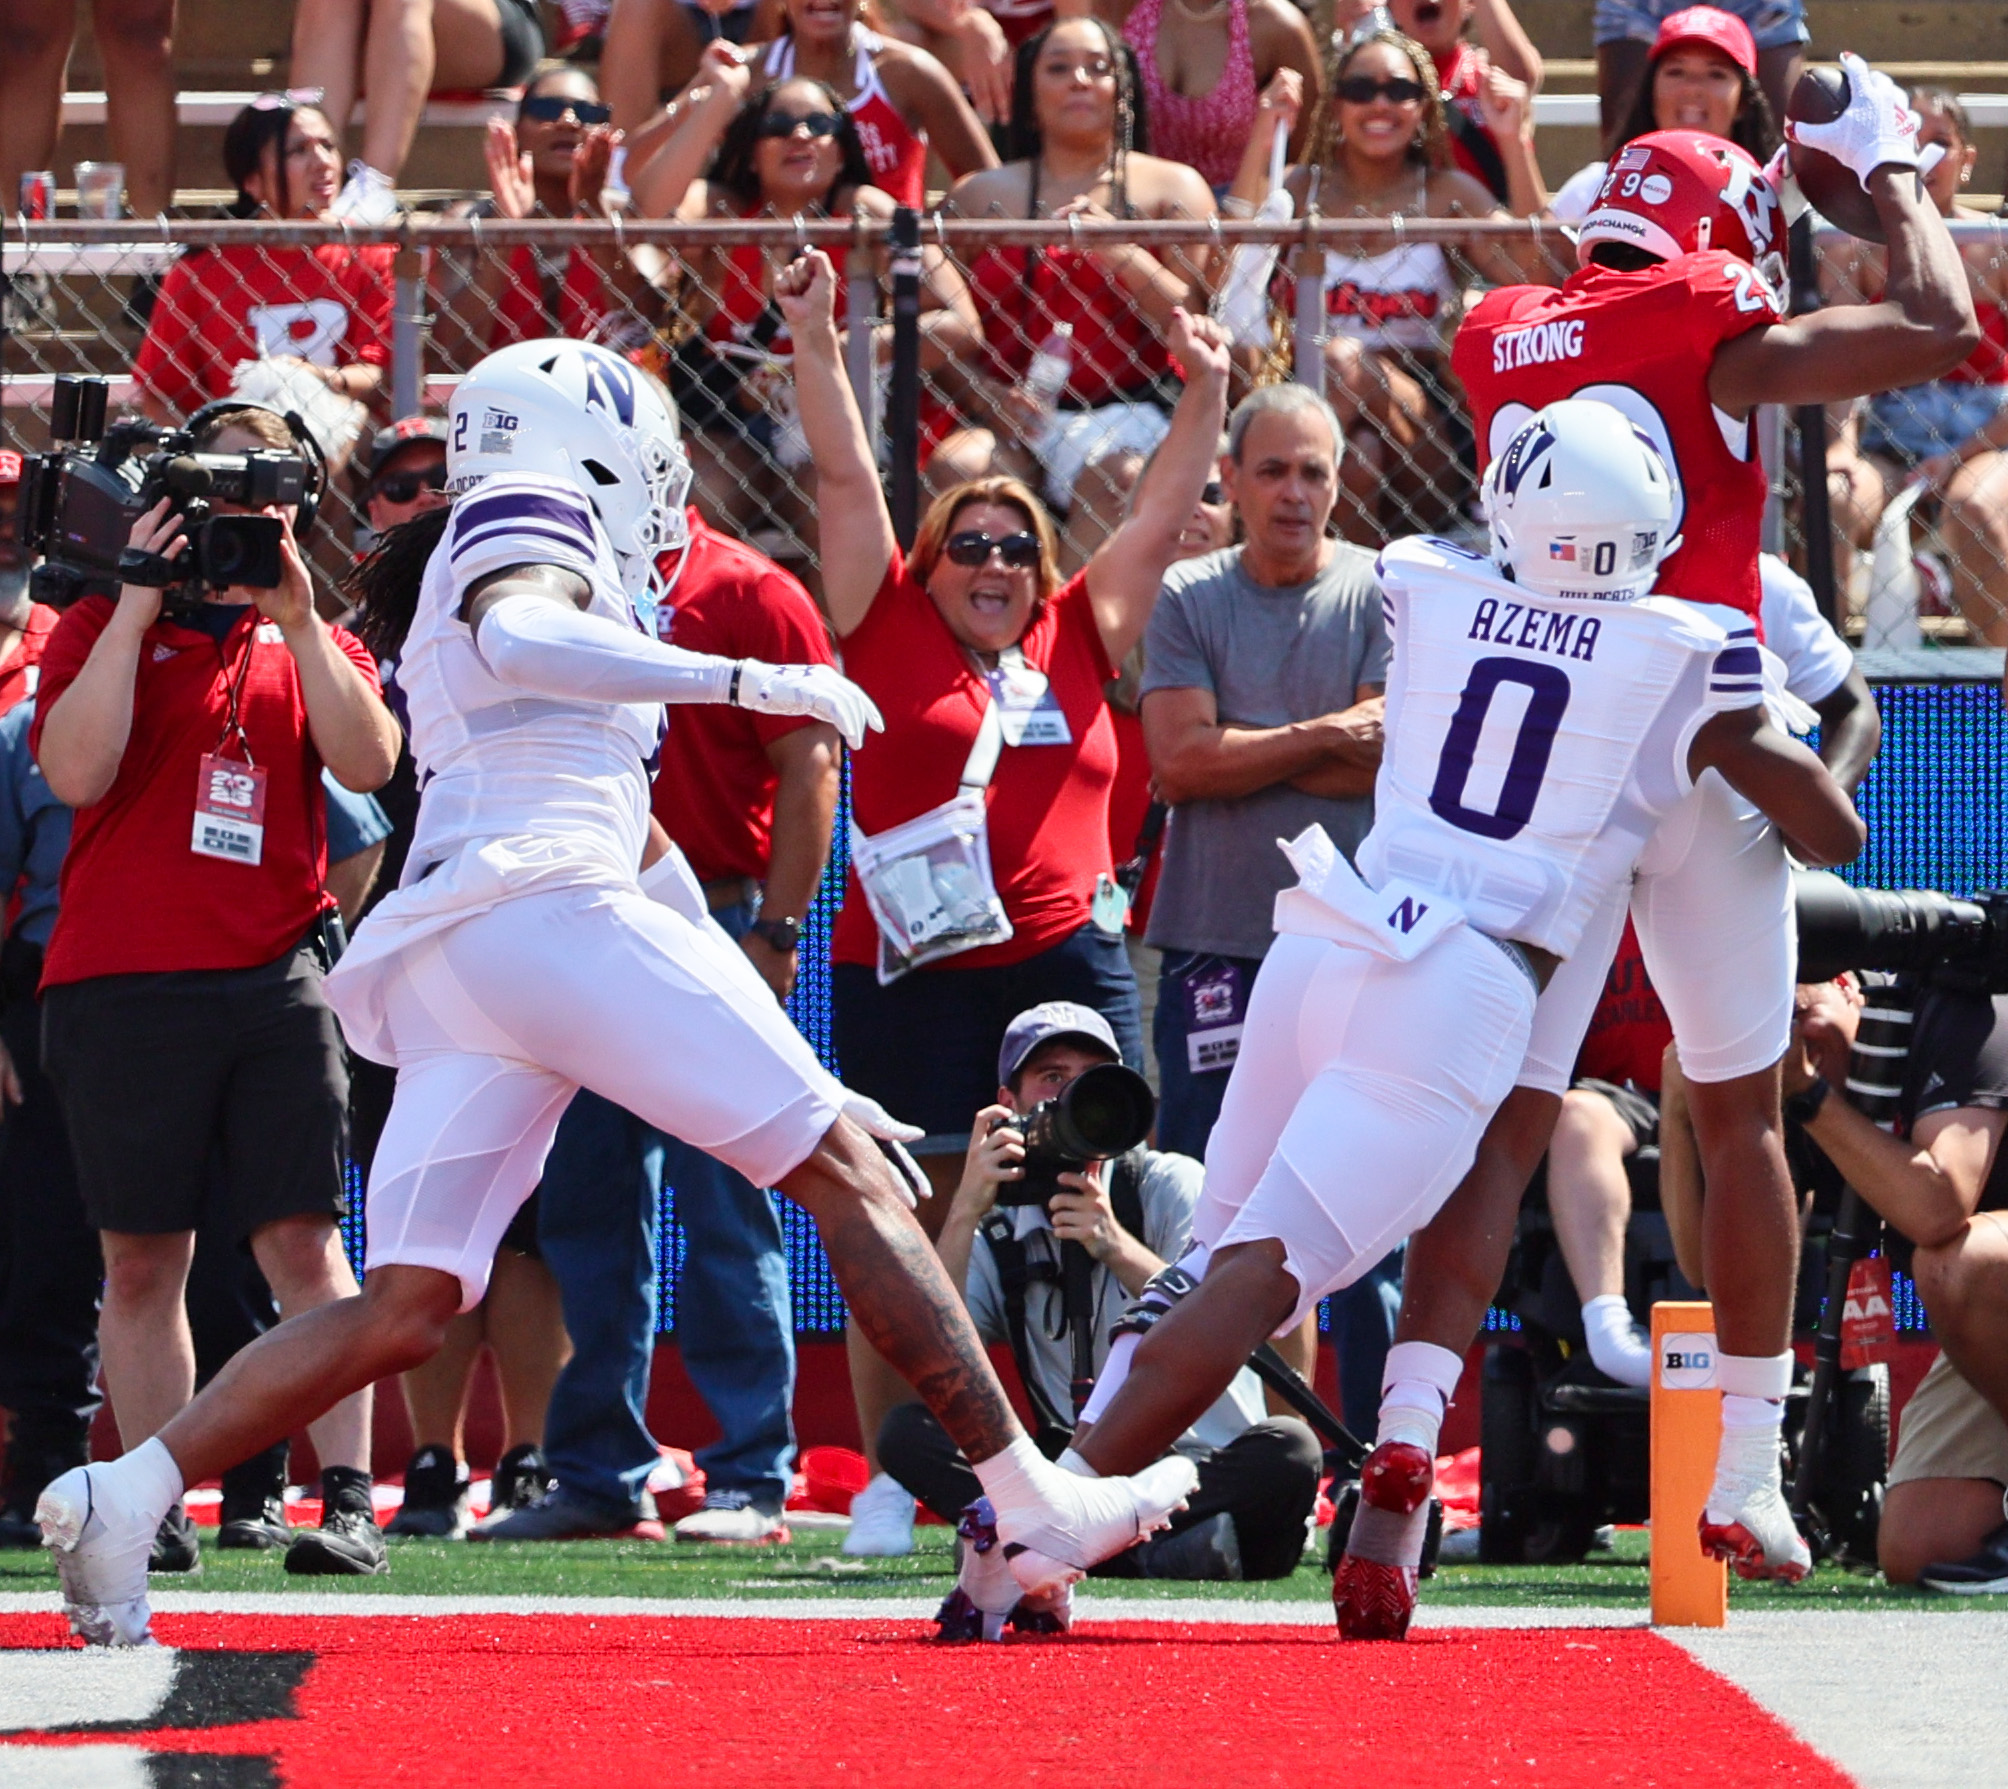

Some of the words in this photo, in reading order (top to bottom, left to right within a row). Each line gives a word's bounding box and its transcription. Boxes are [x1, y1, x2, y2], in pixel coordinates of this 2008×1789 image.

[1493, 320, 1585, 374] STRONG
[455, 412, 468, 453] 2
[1594, 542, 1616, 576] 0
[1468, 598, 1601, 662] AZEMA
[1428, 656, 1570, 841] 0
[1387, 896, 1429, 935] N
